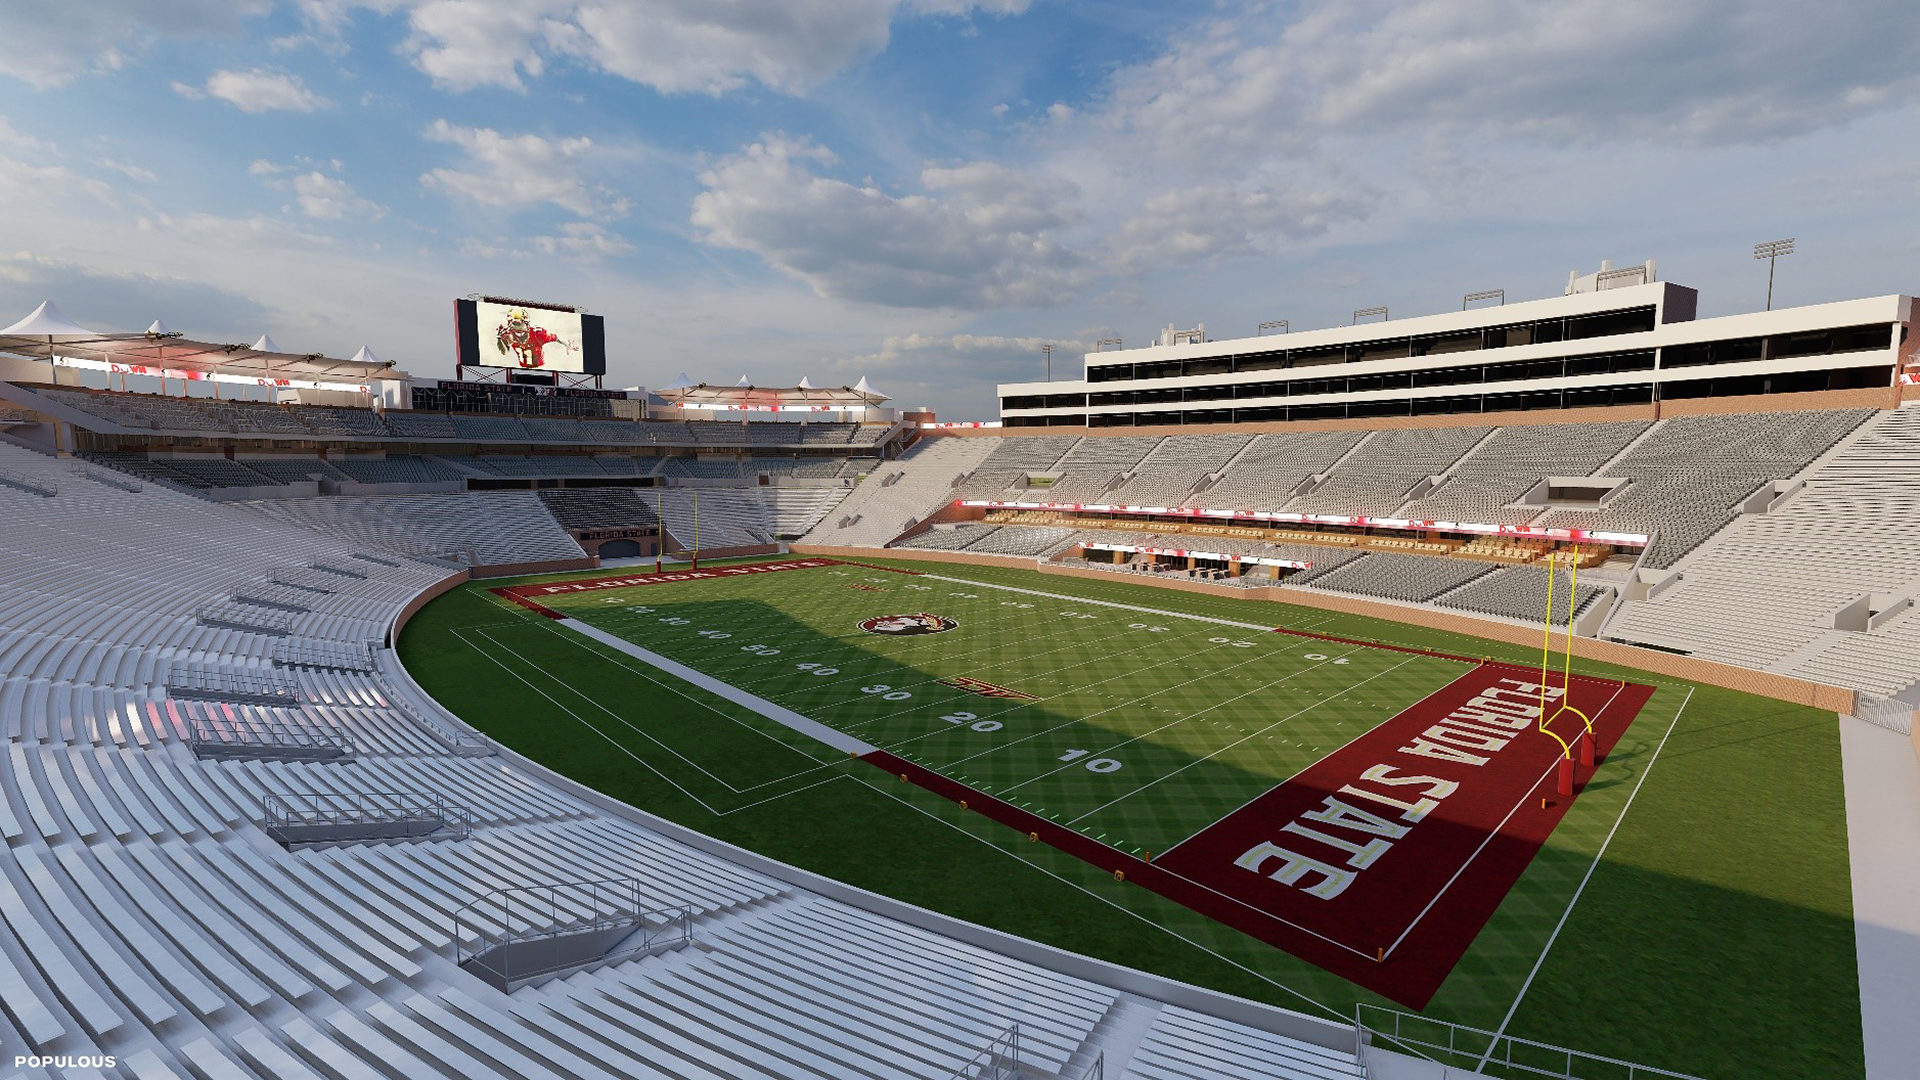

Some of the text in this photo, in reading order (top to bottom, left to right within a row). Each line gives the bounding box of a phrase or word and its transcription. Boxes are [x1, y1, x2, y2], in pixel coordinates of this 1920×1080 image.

[441, 382, 512, 393] FLORIDA STATE
[564, 389, 625, 400] FLORIDA STATE
[589, 529, 651, 540] FLORIDA STATE
[544, 560, 826, 593] FLORIDA STATE
[796, 663, 840, 676] 40
[860, 684, 912, 700] 30
[938, 711, 1003, 732] 20
[1058, 748, 1123, 774] 10
[1233, 677, 1568, 901] FLORIDA STATE
